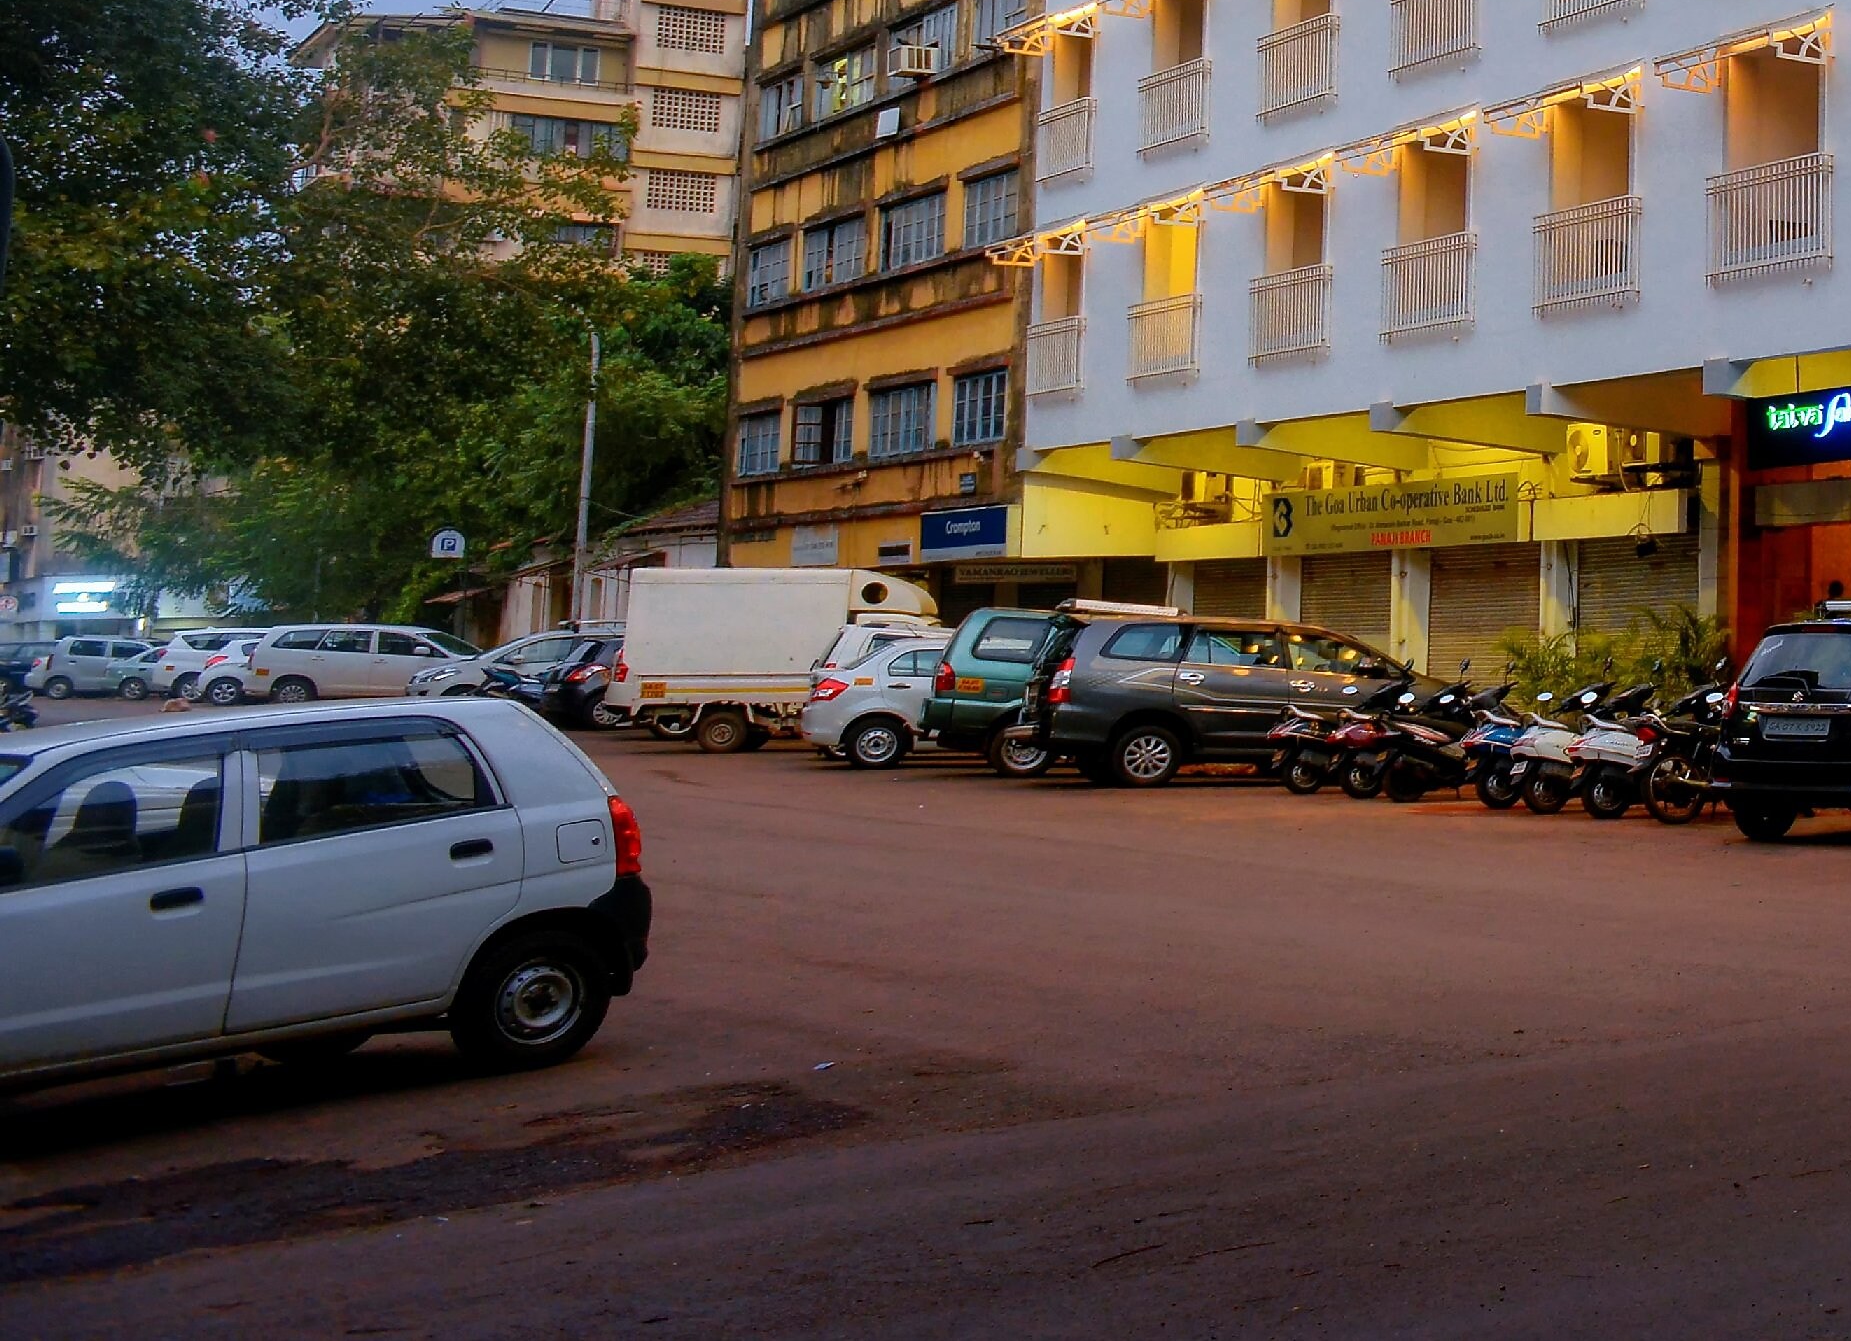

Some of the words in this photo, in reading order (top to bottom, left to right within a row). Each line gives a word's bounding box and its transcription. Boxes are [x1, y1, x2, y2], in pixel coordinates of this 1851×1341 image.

[1305, 495, 1322, 516] The
[1324, 493, 1345, 515] Goa
[1348, 490, 1378, 513] Urban
[1381, 483, 1450, 516] Co-operative
[1453, 480, 1482, 506] Bank
[1485, 479, 1508, 502] Ltd.
[945, 519, 981, 536] Crompton
[443, 539, 455, 550] P
[1399, 529, 1431, 545] BRANCH
